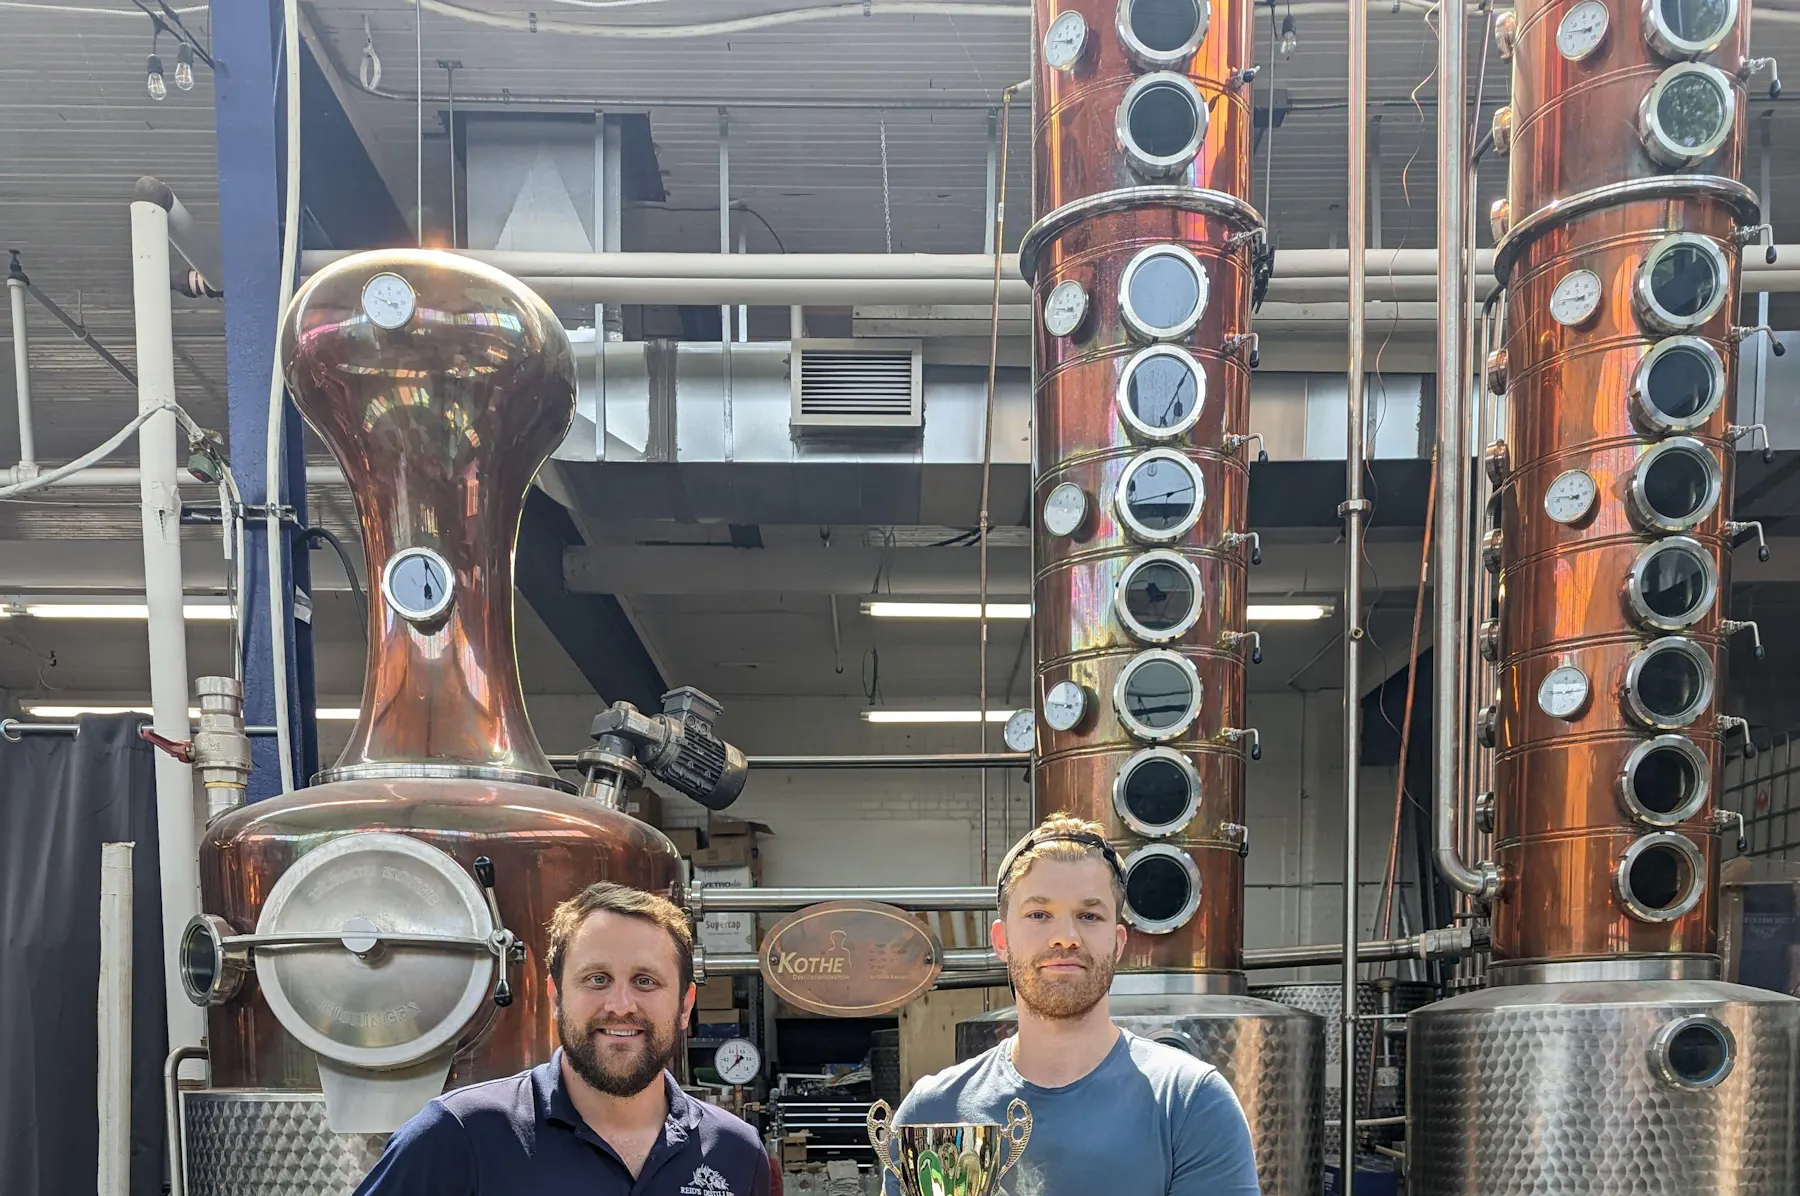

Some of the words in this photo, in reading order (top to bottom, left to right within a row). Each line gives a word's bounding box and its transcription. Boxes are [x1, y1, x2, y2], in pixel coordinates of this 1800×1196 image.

[705, 920, 741, 931] Supercap
[777, 951, 845, 974] KOTHE
[680, 1186, 702, 1196] REID'S
